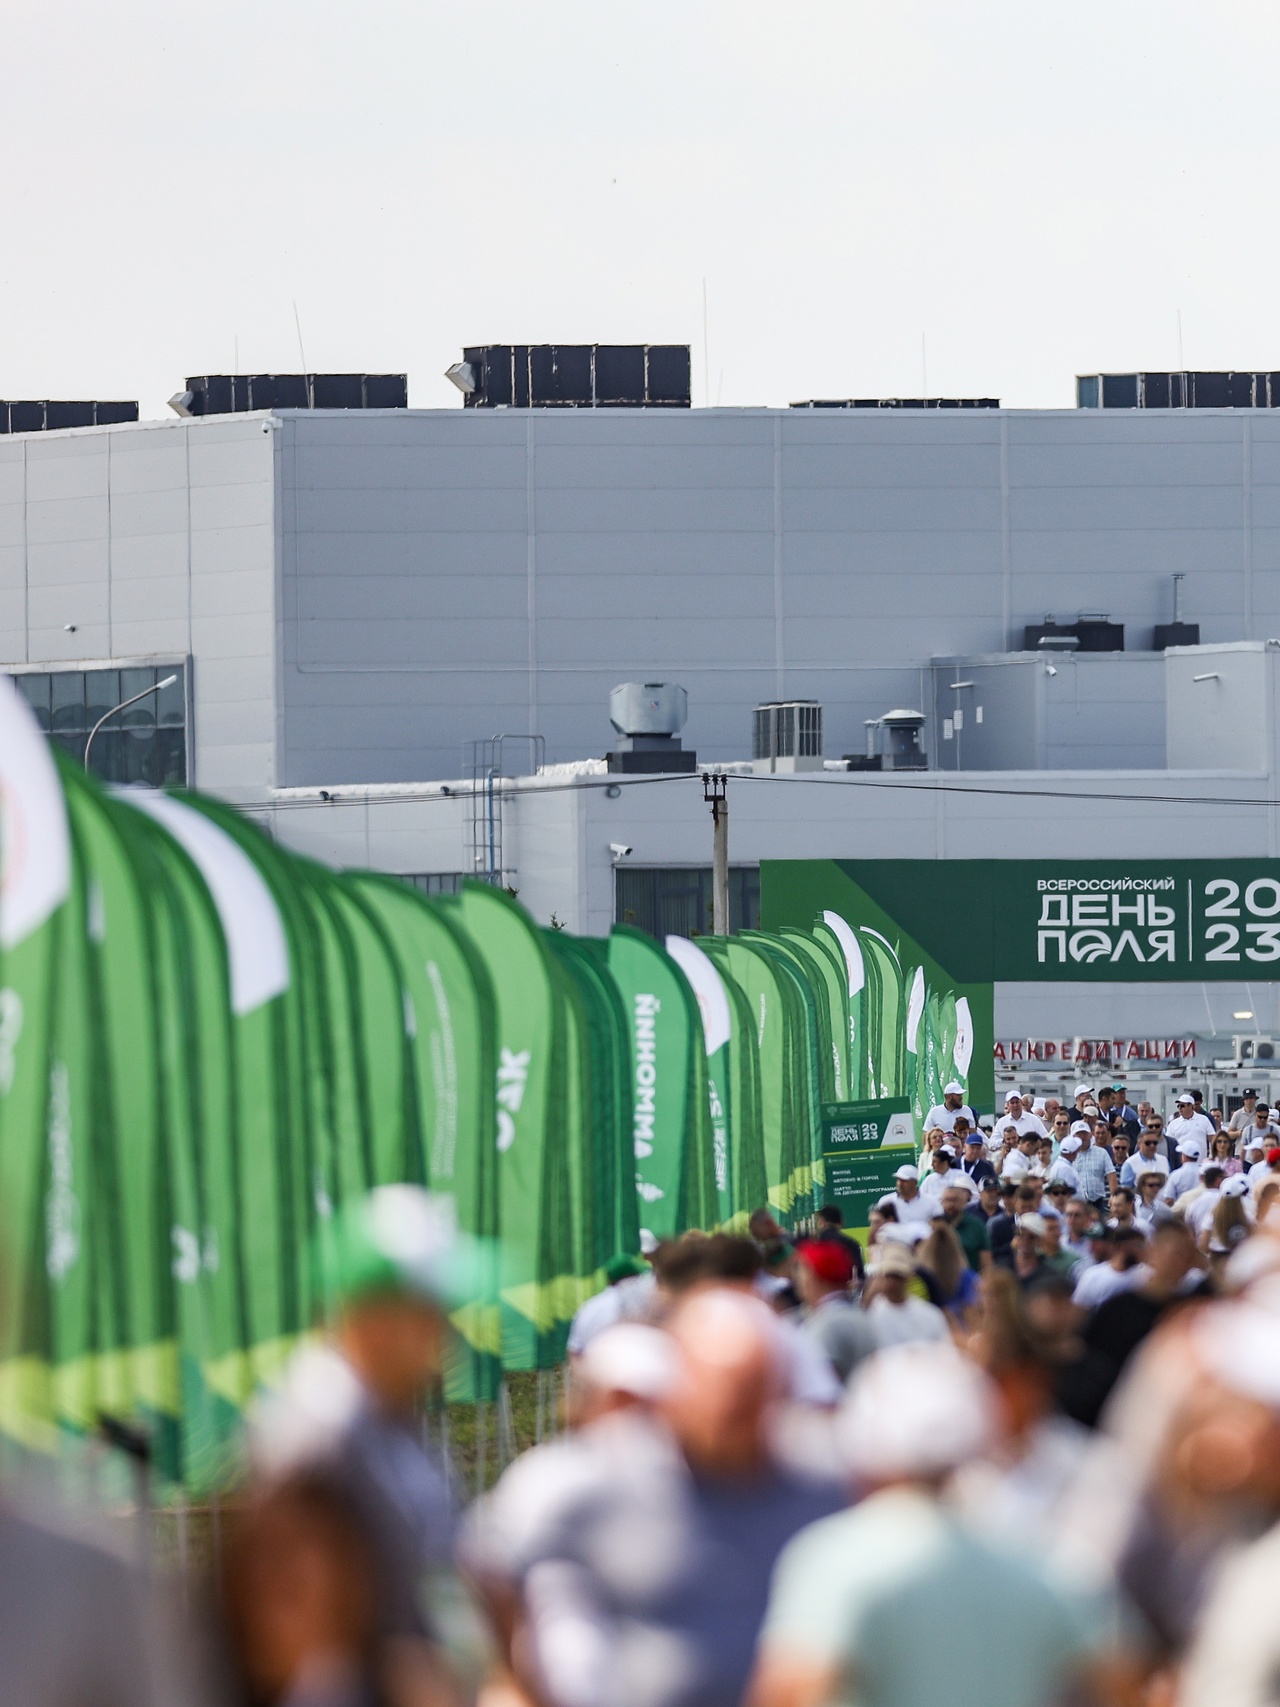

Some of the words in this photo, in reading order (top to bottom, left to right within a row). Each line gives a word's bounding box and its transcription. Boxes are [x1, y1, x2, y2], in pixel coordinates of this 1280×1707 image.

[1037, 876, 1175, 891] ВСЕРОССИЙСКИЙ
[1037, 894, 1176, 927] ДЕНЬ
[1037, 929, 1176, 963] ПОЛЯ
[993, 1039, 1197, 1062] АККРЕДИТАЦИИ
[861, 1123, 878, 1132] 20
[862, 1132, 878, 1140] 23
